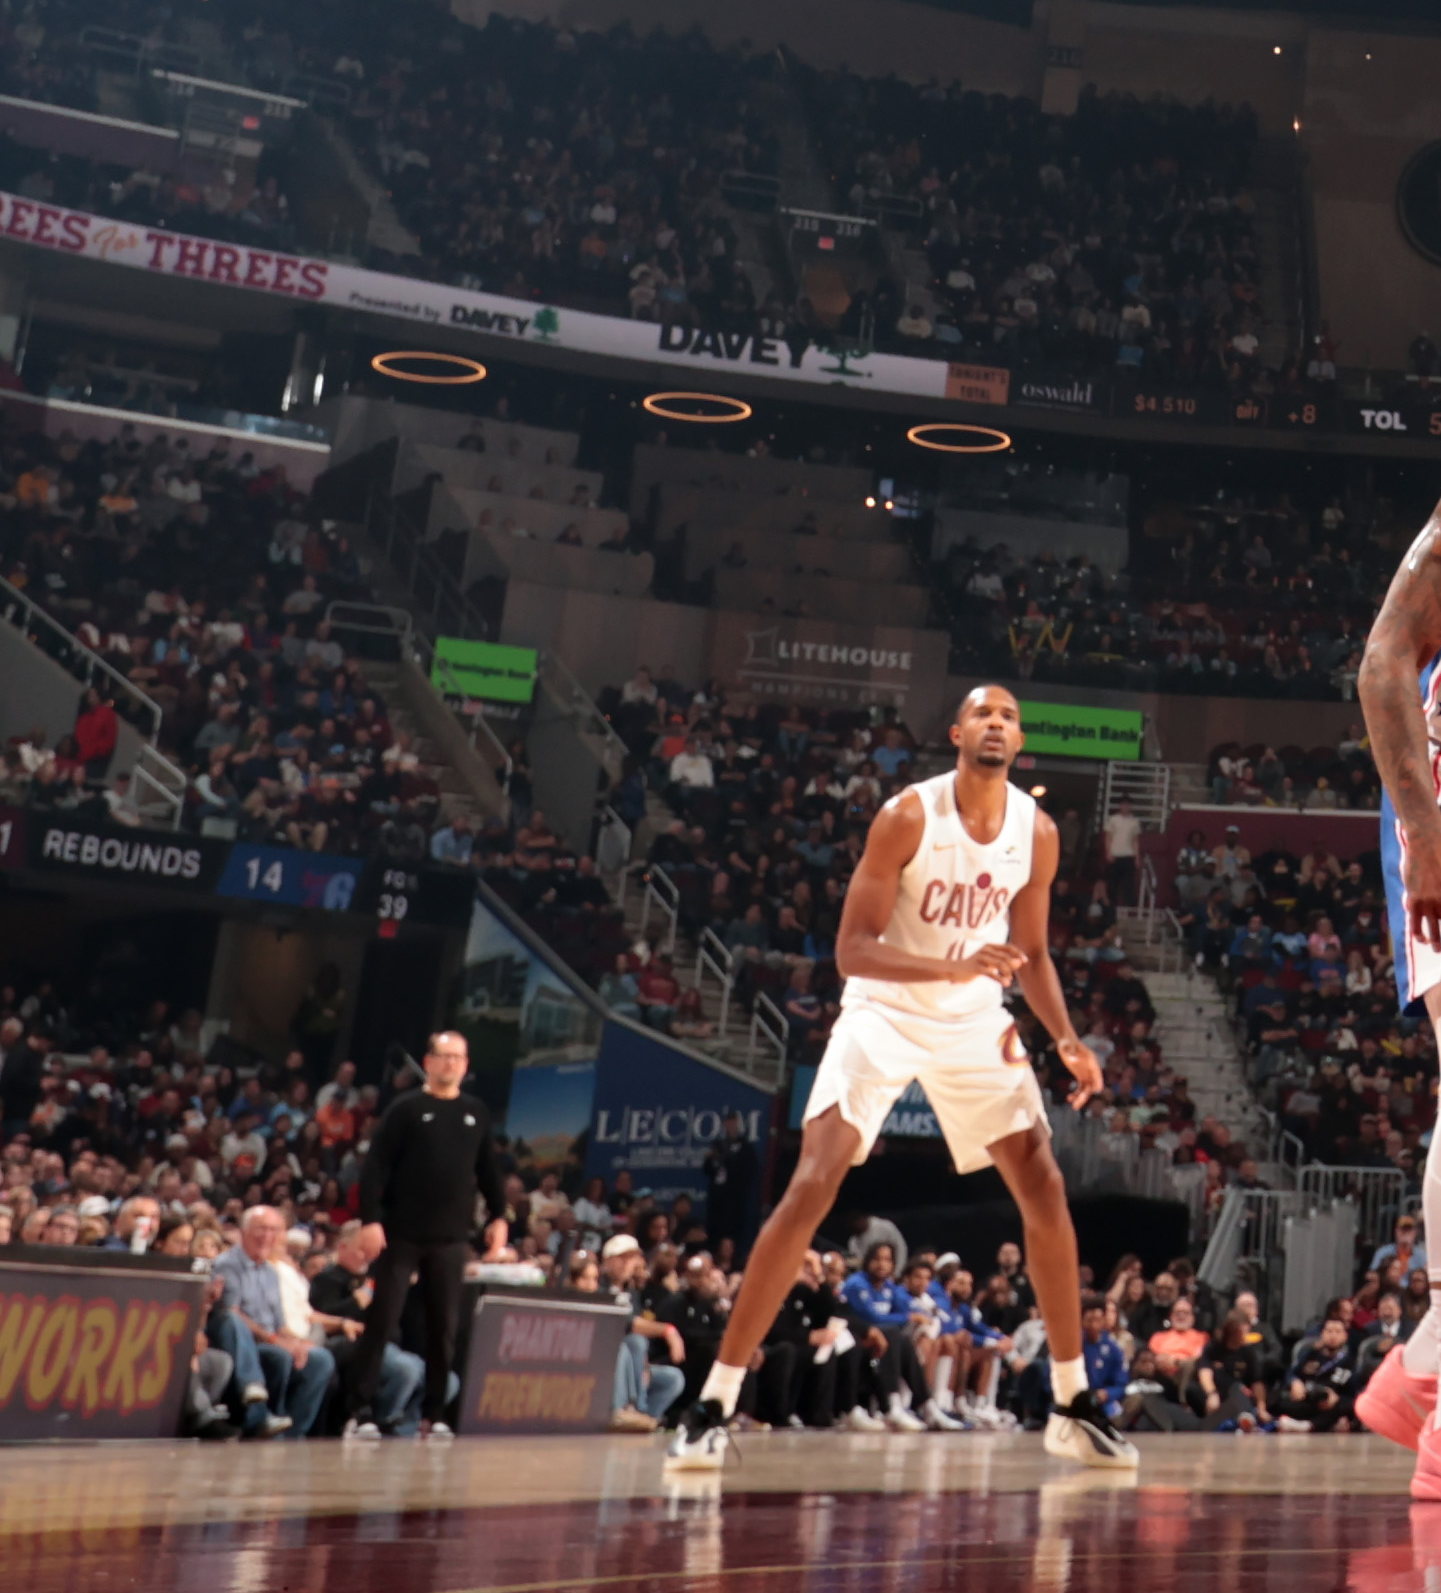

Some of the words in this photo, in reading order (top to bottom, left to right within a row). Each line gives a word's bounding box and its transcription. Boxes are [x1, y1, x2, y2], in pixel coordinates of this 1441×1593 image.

[0, 198, 90, 253] EES
[147, 231, 329, 301] THREES
[449, 304, 531, 337] DAVEY
[659, 322, 814, 370] DAVEY
[1020, 380, 1093, 408] oswald
[1360, 409, 1408, 431] TOL
[778, 639, 912, 671] LITEHOUSE
[1021, 720, 1096, 741] untington
[1099, 725, 1138, 743] Bank
[43, 827, 202, 881] REBOUNDS
[245, 856, 283, 893] 14
[378, 893, 408, 920] 39
[919, 879, 1009, 929] CAVS
[499, 1311, 596, 1364] PHANTOM
[477, 1368, 596, 1422] FIREWORKS
